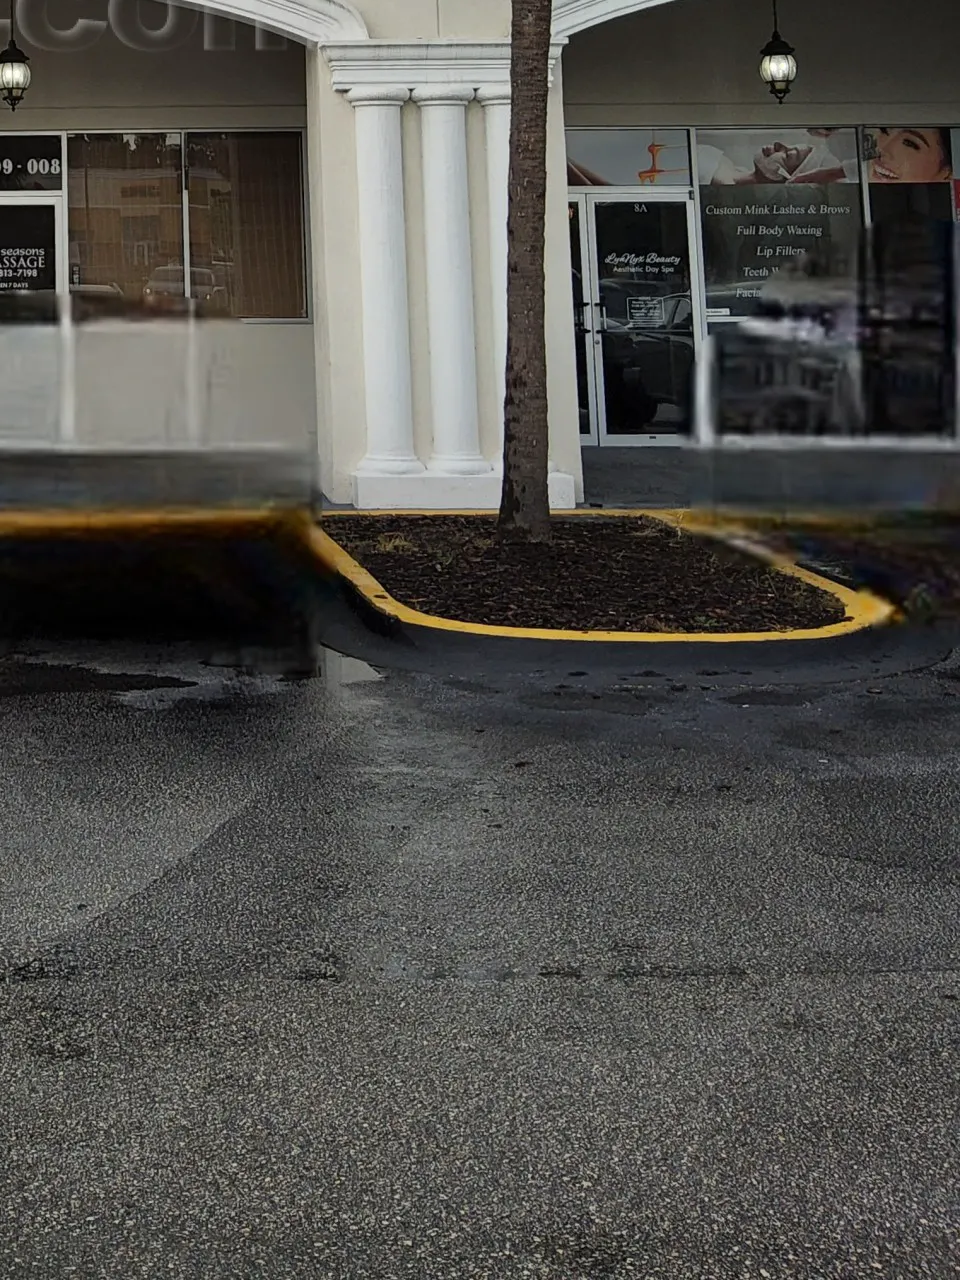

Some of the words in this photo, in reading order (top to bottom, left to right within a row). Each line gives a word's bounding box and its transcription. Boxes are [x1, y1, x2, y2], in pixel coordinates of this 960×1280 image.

[634, 203, 648, 213] 8A
[705, 205, 741, 215] Custom
[744, 205, 770, 215] Mink
[773, 204, 805, 215] Lashes
[808, 205, 817, 214] &
[820, 204, 851, 214] Brows
[736, 225, 756, 235] Full
[758, 225, 784, 237] Body
[787, 225, 823, 237] Waxing
[0, 248, 45, 256] seasons
[756, 246, 773, 258] Lip
[776, 246, 806, 256] Fillers
[645, 252, 681, 265] Beauty
[645, 266, 660, 274] Day
[661, 266, 674, 274] Spa
[743, 267, 769, 277] Teeth
